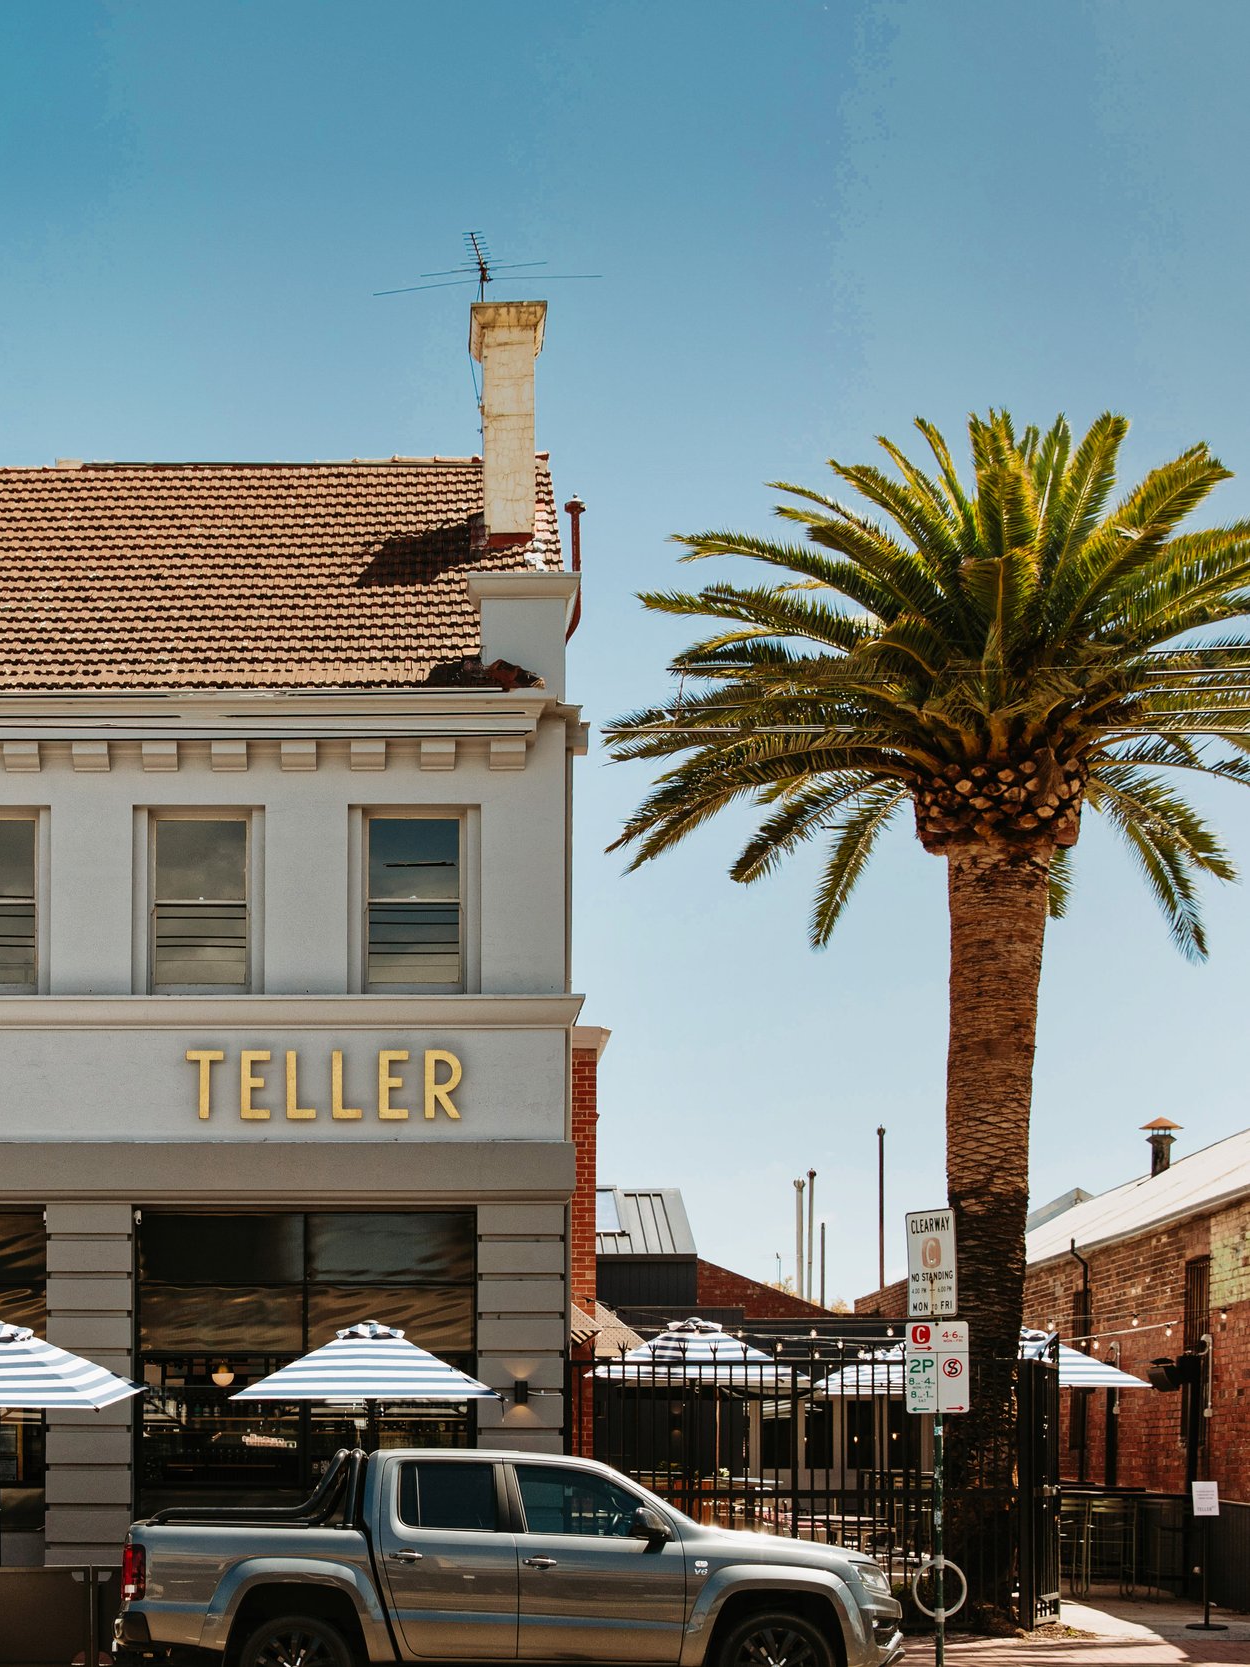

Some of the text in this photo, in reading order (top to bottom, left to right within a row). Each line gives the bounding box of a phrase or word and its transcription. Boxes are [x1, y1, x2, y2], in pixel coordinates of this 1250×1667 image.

[186, 1050, 462, 1119] TELLER
[911, 1216, 949, 1234] CLEARWAY
[911, 1271, 953, 1282] NO STANDING
[913, 1302, 928, 1311] MON
[941, 1301, 952, 1309] FRI
[917, 1327, 925, 1342] C
[910, 1359, 934, 1373] 2P
